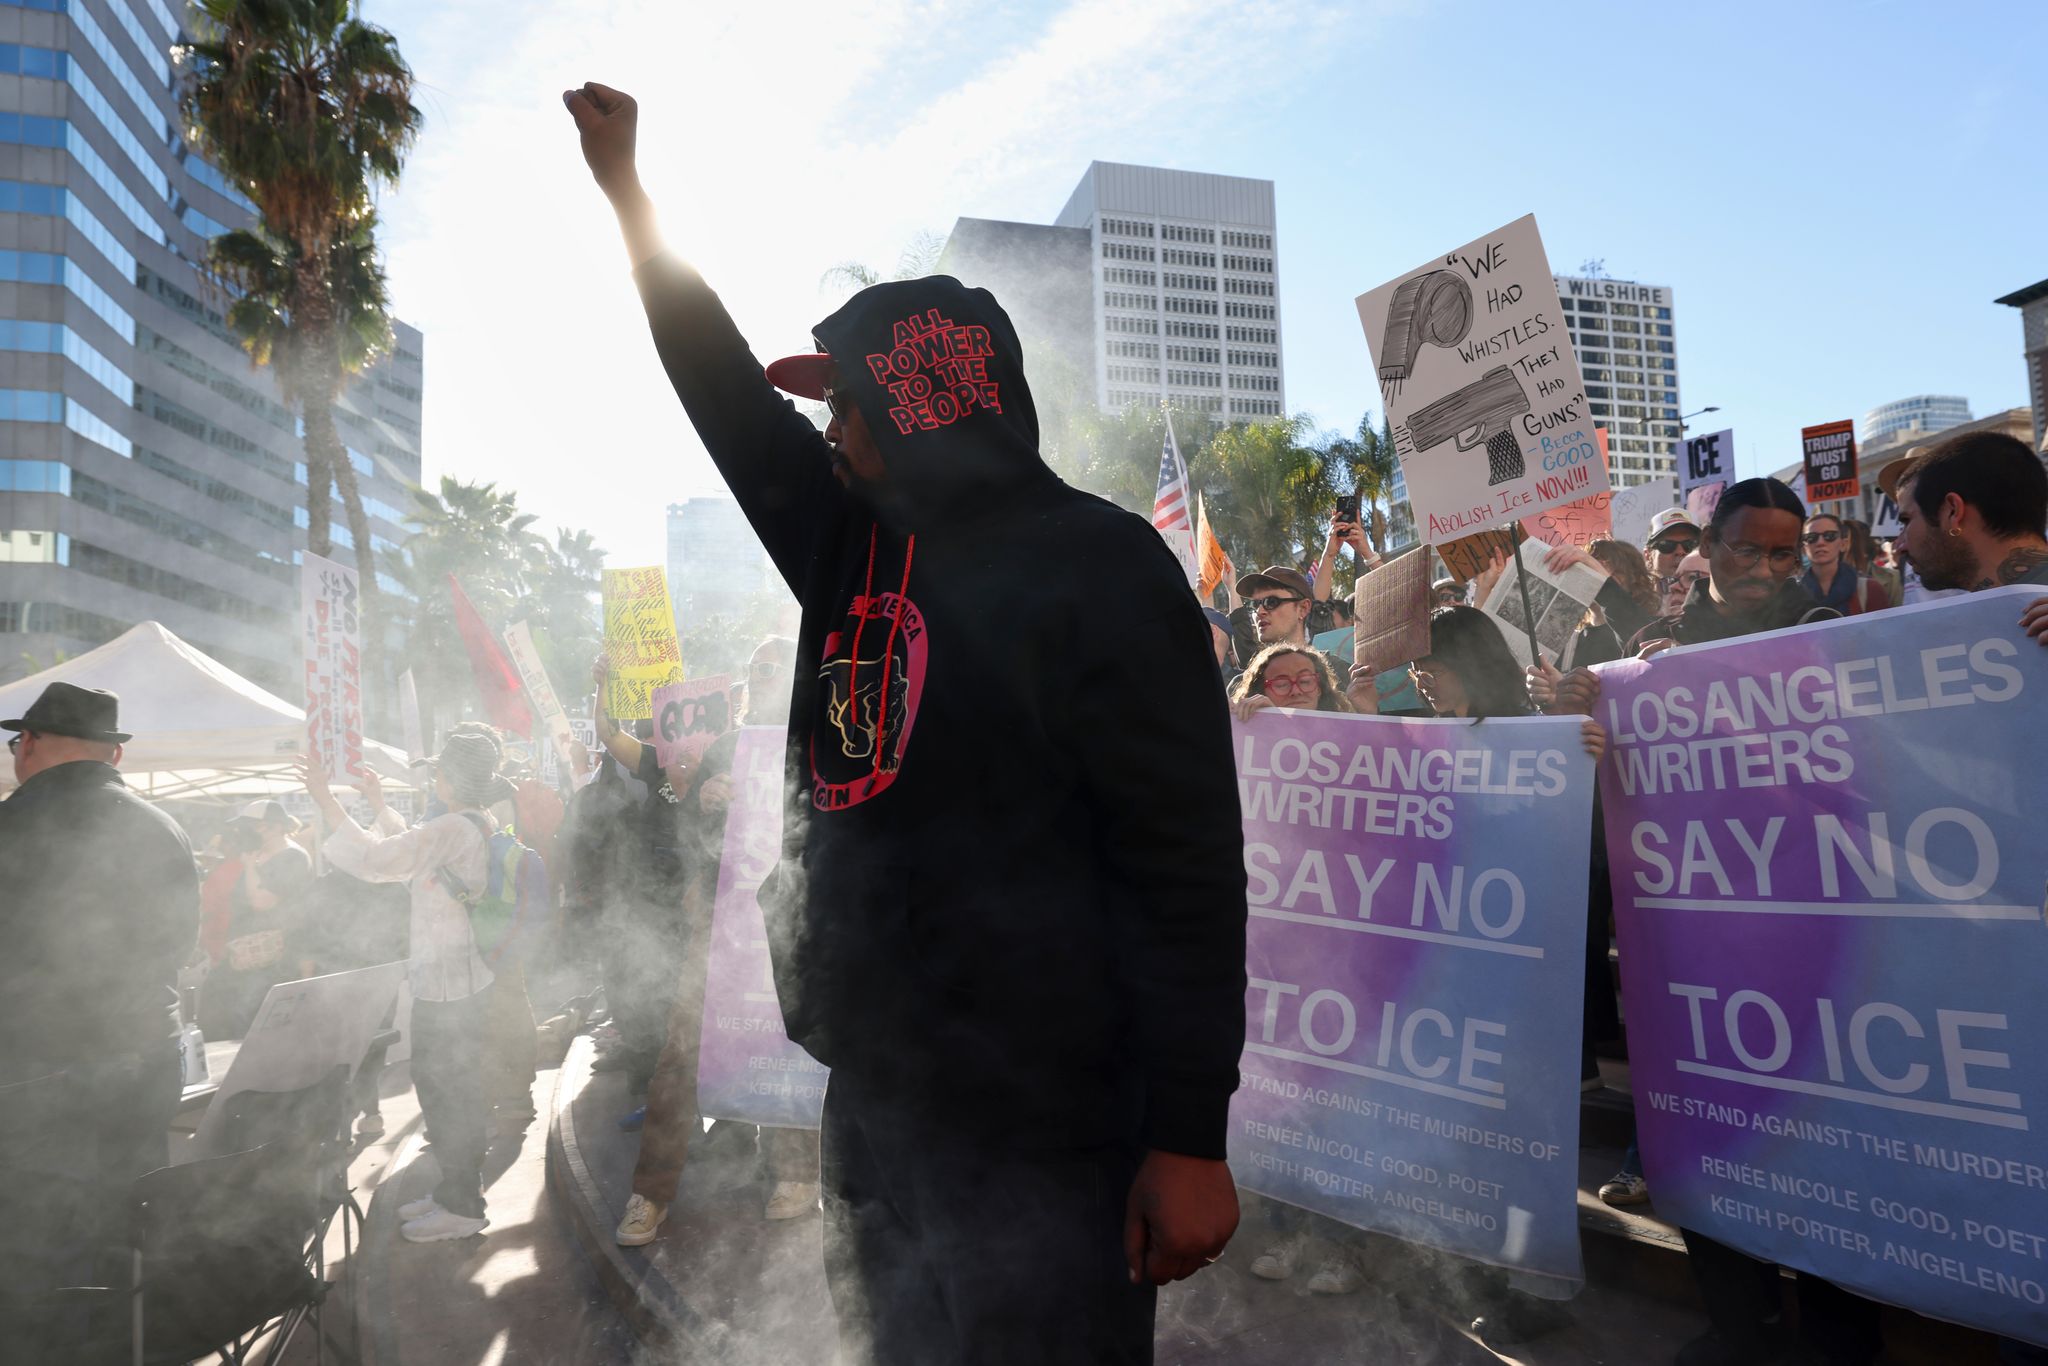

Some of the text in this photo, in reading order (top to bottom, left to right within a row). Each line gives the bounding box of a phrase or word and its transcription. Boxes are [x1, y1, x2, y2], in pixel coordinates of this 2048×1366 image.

[1486, 283, 1523, 314] HAD
[1568, 279, 1662, 304] WILSHIRE
[866, 325, 995, 384] POWER
[894, 308, 954, 347] ALL
[1457, 313, 1555, 365] WHISTLES.
[888, 357, 988, 405] TO THE
[1512, 346, 1560, 378] THEY
[1537, 378, 1565, 398] HAD
[889, 381, 1003, 435] PEOPLE
[1541, 430, 1584, 450] BECCA
[1543, 443, 1594, 472] GOOD
[1687, 434, 1721, 480] ICE
[1804, 432, 1852, 453] TRUMP
[1810, 448, 1848, 467] MUST
[1428, 504, 1493, 539] ABOLISH
[1535, 466, 1590, 501] NOW!!!
[1813, 481, 1852, 499] NOW!
[1821, 465, 1840, 481] GO
[315, 599, 330, 661] DUE
[343, 572, 363, 778] NO PERSON
[1608, 637, 2024, 745] LOS ANGELES
[318, 675, 336, 780] PROCESS
[1242, 735, 1567, 797] LOS ANGELES
[1612, 725, 1855, 796] WRITERS
[1240, 778, 1454, 840] WRITERS
[1630, 807, 1999, 900] SAY NO
[1243, 842, 1526, 939] SAY NO
[716, 1015, 787, 1034] WE STAN
[1247, 976, 1506, 1095] TO ICE
[1668, 981, 2022, 1109] TO ICE
[750, 1082, 791, 1098] KEITH
[1240, 1073, 1560, 1162] STAND AGAINST THE MURDERS OF
[1245, 1119, 1504, 1201] RENÉE NICOLE GOOD, POET
[1648, 1091, 2048, 1192] WE STAND AGAINST THE MURDER
[1249, 1151, 1497, 1232] KEITH PORTER, ANGELENO
[1701, 1155, 2047, 1259] RENÉE NICOLE GOOD, POET
[1711, 1194, 2046, 1305] KEITH PORTER, ANGELENO
